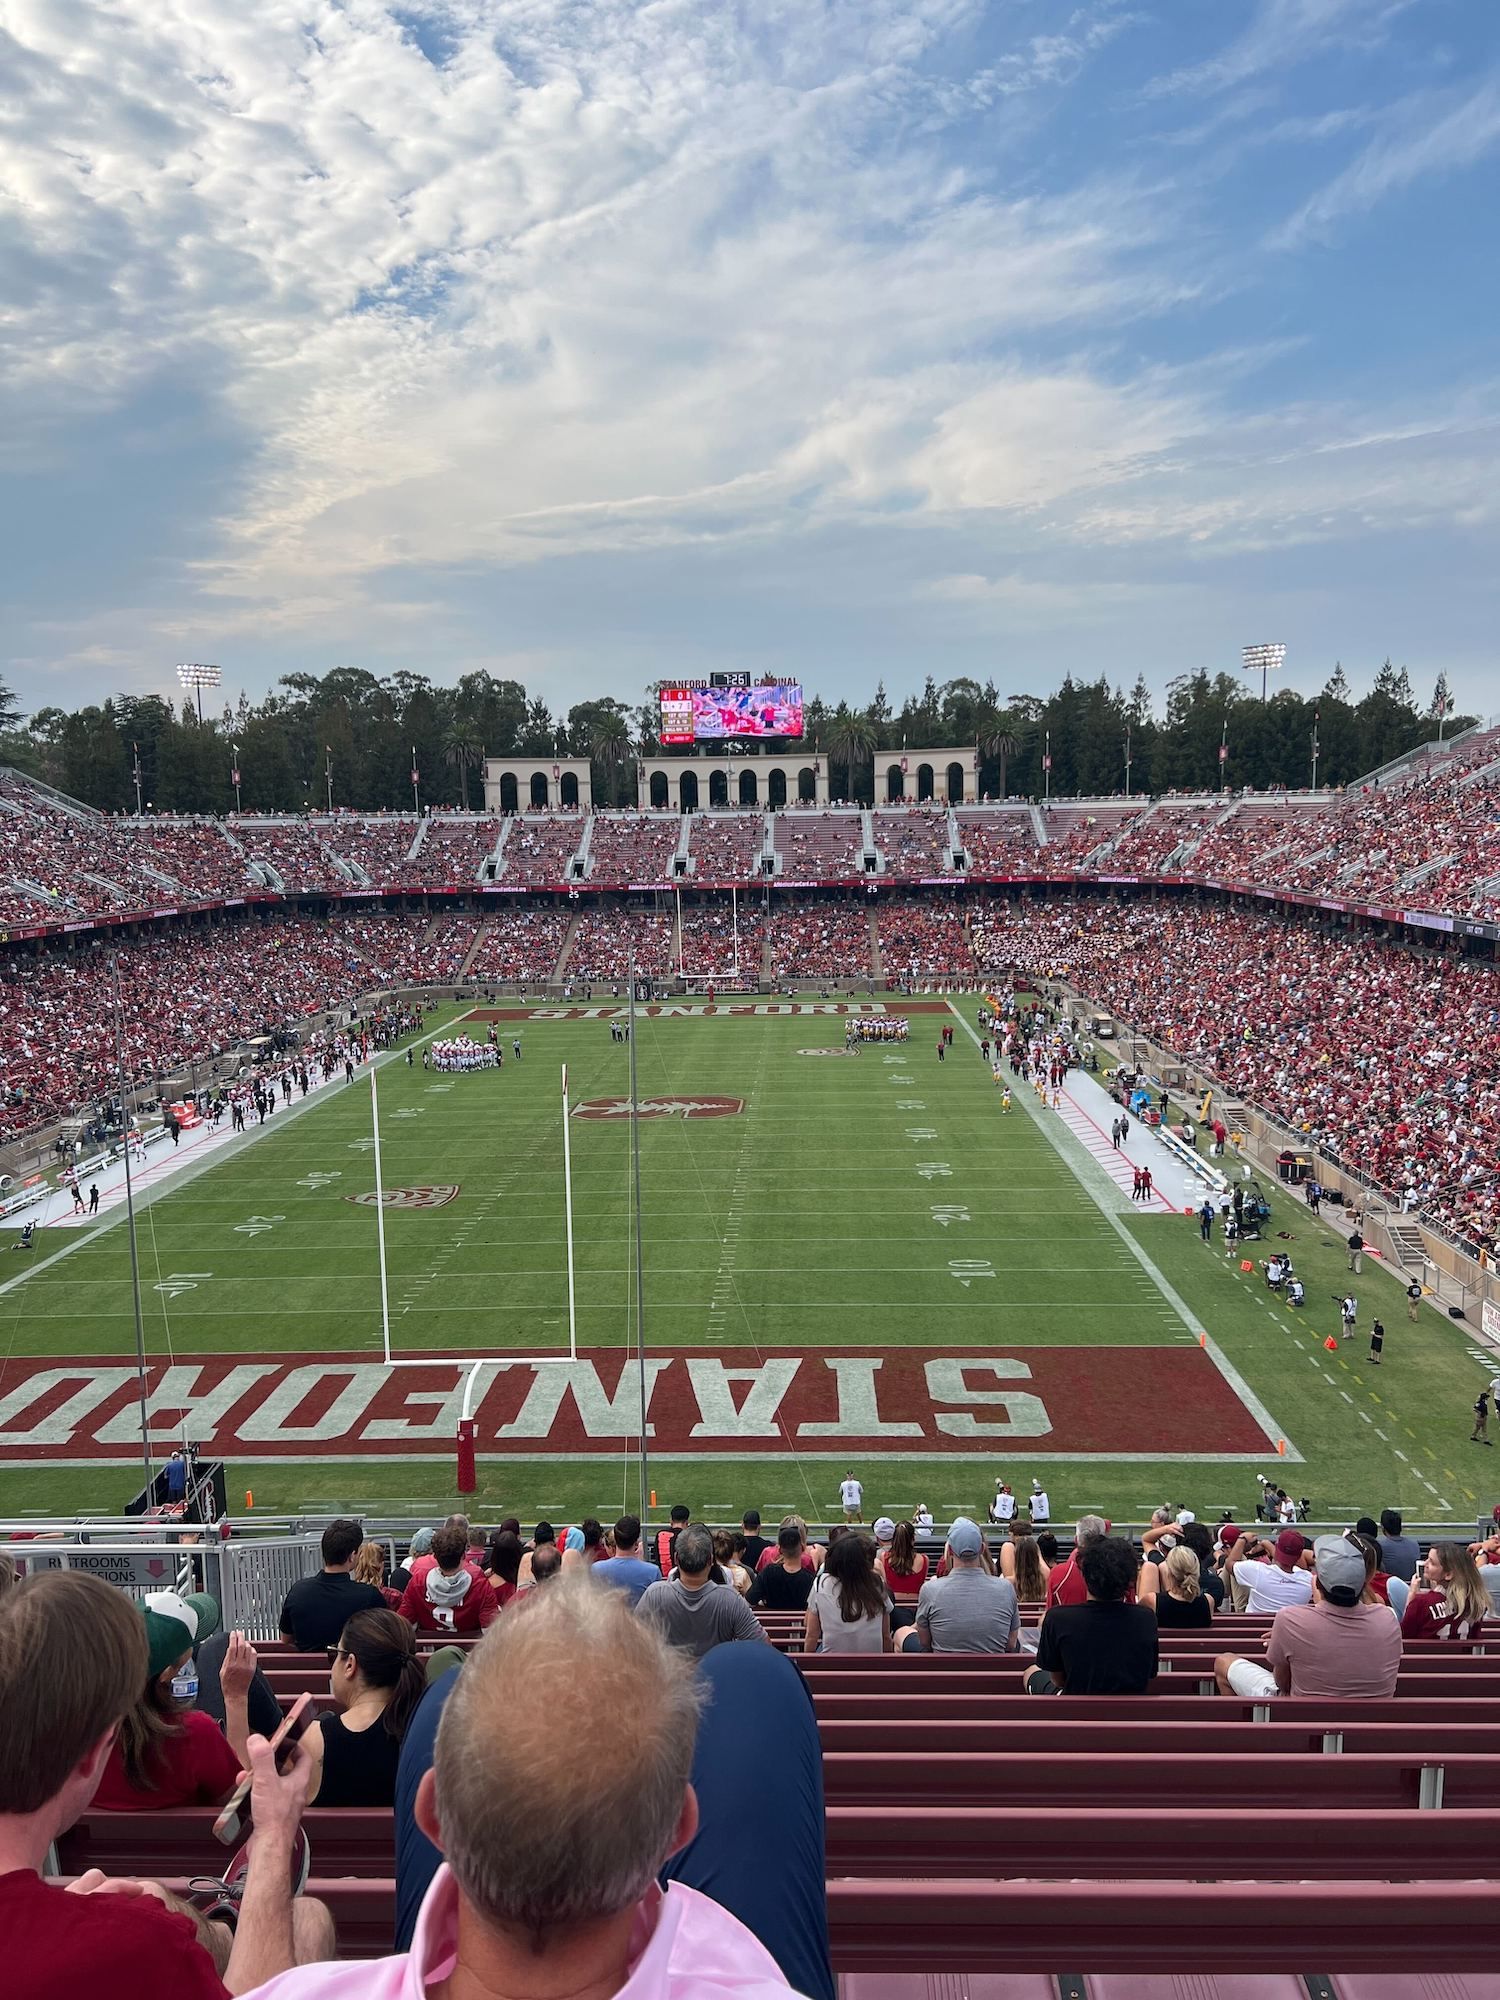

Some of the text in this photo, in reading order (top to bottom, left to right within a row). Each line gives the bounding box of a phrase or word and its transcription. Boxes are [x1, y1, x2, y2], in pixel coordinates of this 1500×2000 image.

[660, 677, 798, 688] STANFORD CADINAL
[724, 674, 745, 685] 7:26
[568, 890, 579, 899] 25
[867, 885, 877, 893] 25
[527, 1003, 888, 1020] STANFORD
[916, 1162, 953, 1176] 30
[296, 1171, 342, 1186] 30
[929, 1204, 971, 1221] 20
[233, 1215, 287, 1232] 20
[948, 1259, 997, 1278] 10
[153, 1272, 214, 1292] 10
[0, 1358, 1054, 1445] STANFORD
[48, 1557, 130, 1569] RETROOMS
[432, 1606, 458, 1633] 9
